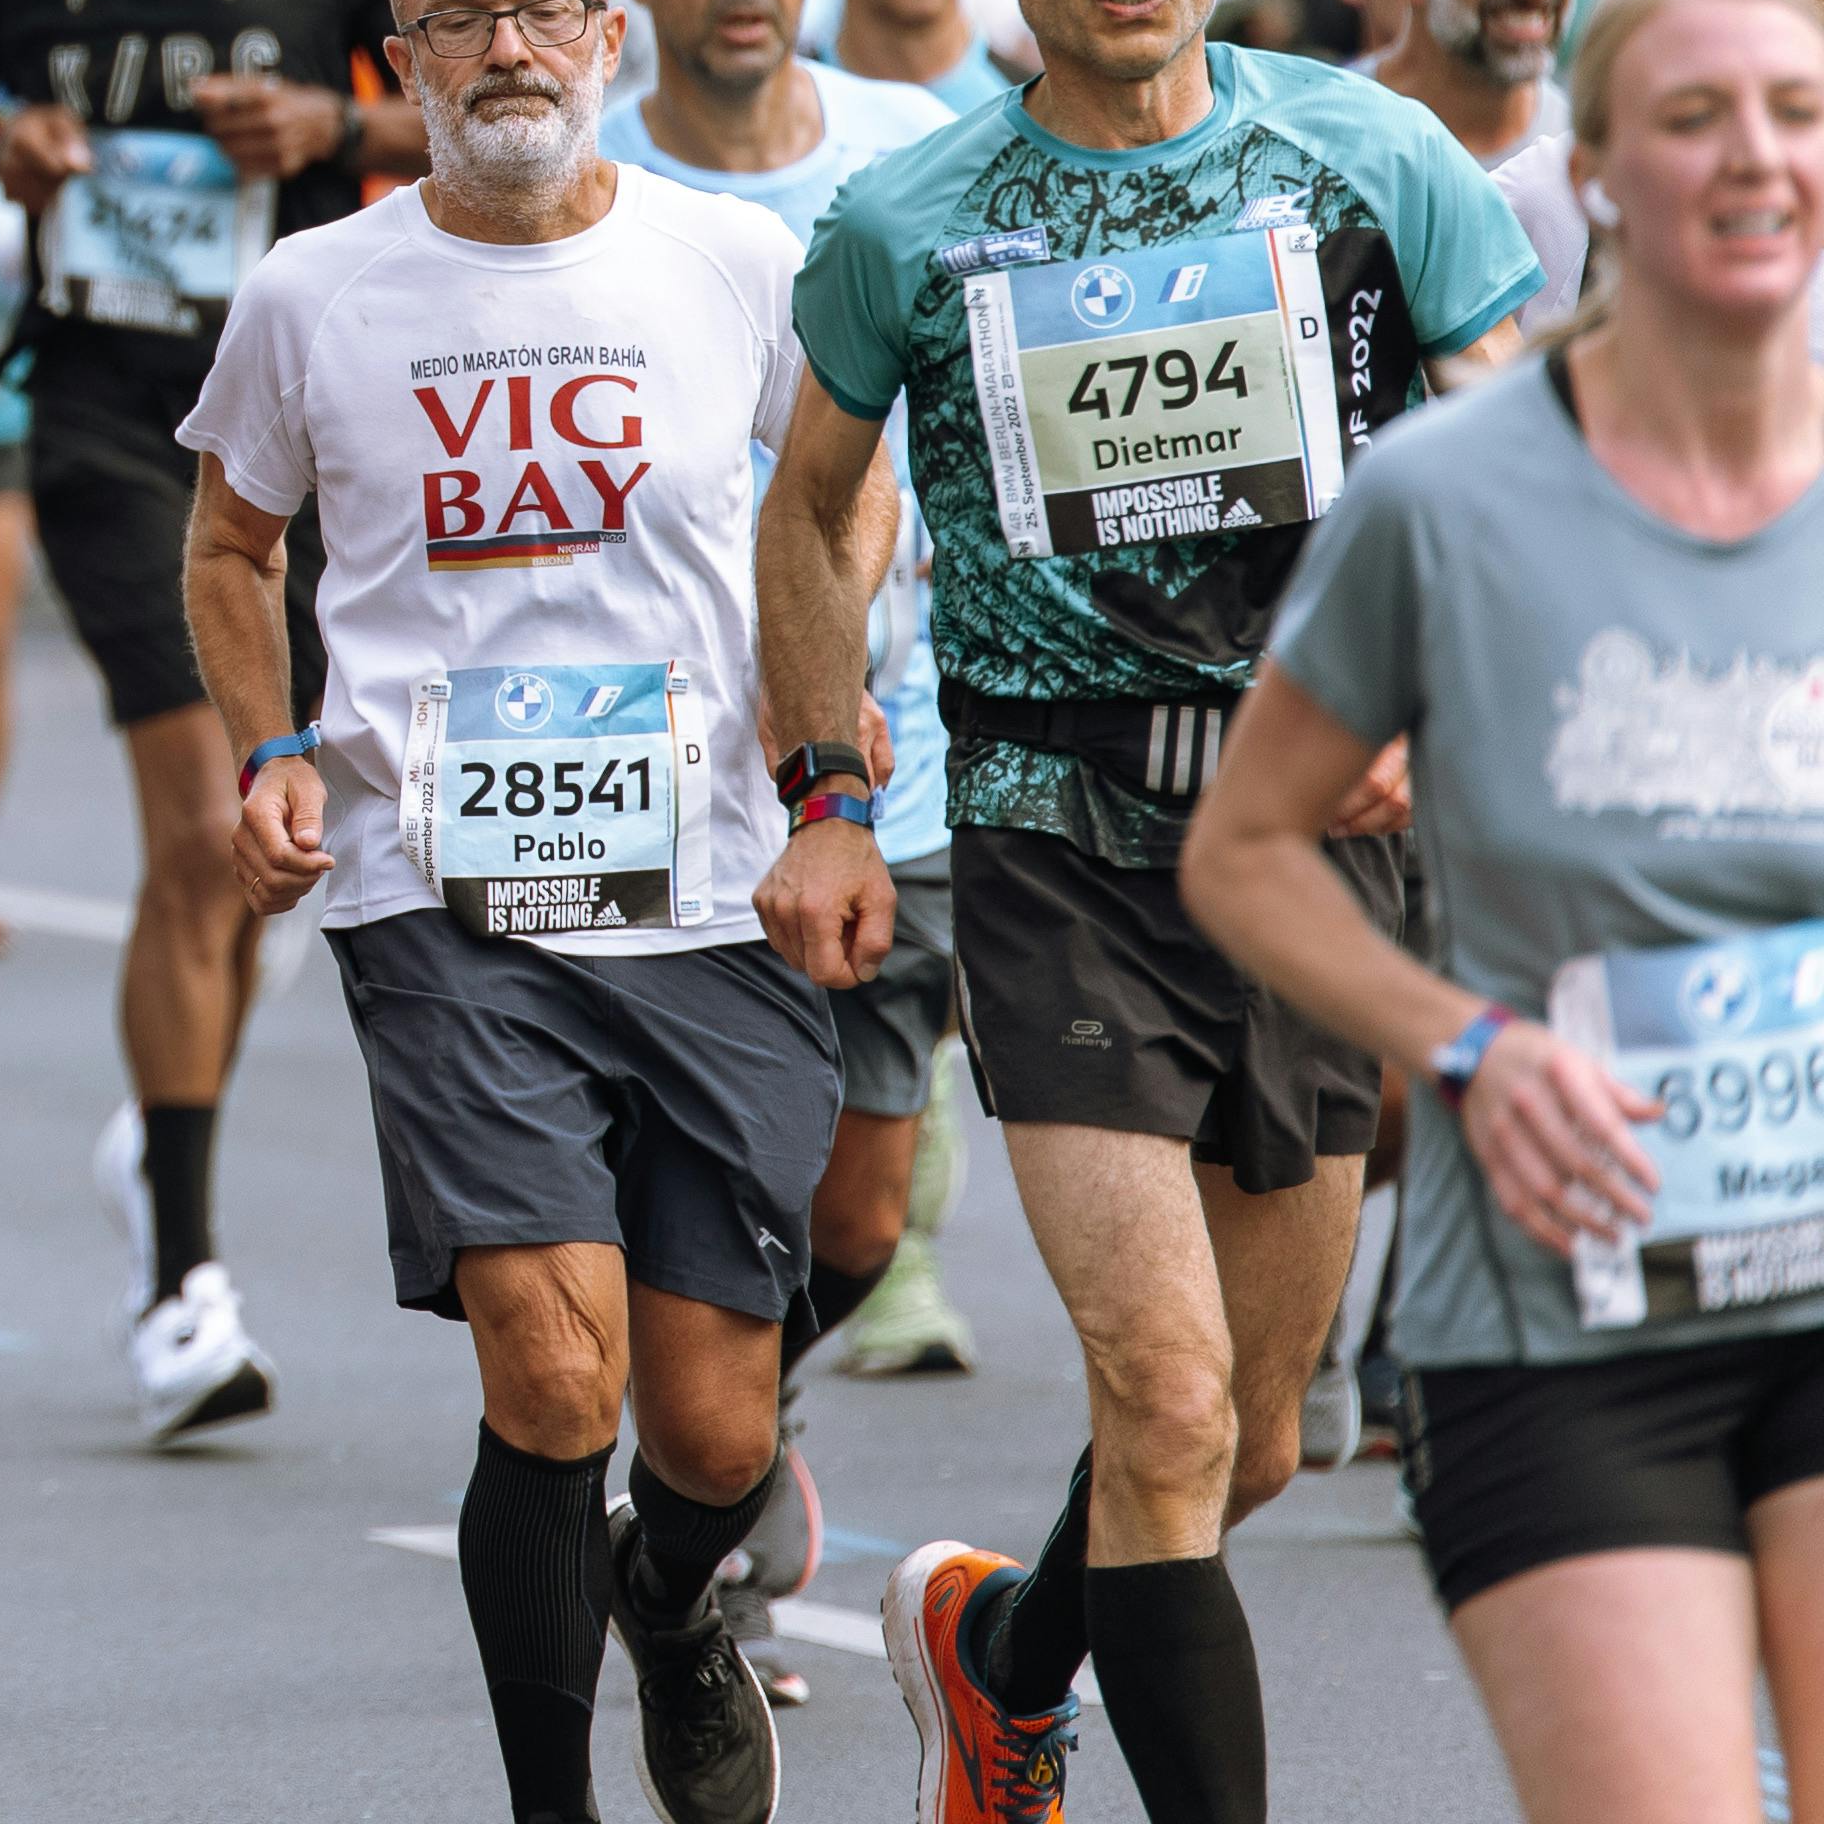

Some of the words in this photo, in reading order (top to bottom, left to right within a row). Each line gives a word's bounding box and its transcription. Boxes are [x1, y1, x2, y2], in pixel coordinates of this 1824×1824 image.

[1078, 270, 1123, 289] BMW
[1299, 317, 1320, 340] D
[1348, 288, 1383, 398] 2022
[410, 355, 459, 380] MEDIO
[463, 344, 542, 373] MARATÓN
[547, 345, 594, 366] GRAN
[599, 344, 647, 369] BAHÍA
[977, 306, 1013, 461] BERLIN-MARATHON
[1067, 339, 1249, 421] 4794
[413, 374, 643, 459] VIG
[1007, 395, 1023, 430] 2022
[1092, 426, 1243, 471] Dietmar
[1000, 464, 1020, 505] BMW
[1015, 432, 1036, 505] September
[423, 460, 653, 541] BAY
[1091, 475, 1224, 519] IMPOSSIBLE
[1026, 505, 1039, 529] 25.
[1096, 520, 1121, 547] IS
[1121, 506, 1221, 545] NOTHING
[1220, 513, 1262, 528] adidas
[557, 541, 600, 555] NIGRÁN
[600, 532, 626, 544] VIGO
[531, 555, 574, 567] BAIONA
[503, 676, 546, 694] BMW
[686, 743, 701, 765] D
[421, 781, 435, 814] 2022
[459, 756, 651, 817] 28541
[422, 816, 435, 885] September
[513, 832, 607, 862] Pablo
[487, 877, 601, 906] IMPOSSIBLE
[488, 906, 508, 933] IS
[510, 902, 593, 932] NOTHING
[593, 915, 627, 927] adidas
[1061, 1034, 1112, 1051] Kalenji
